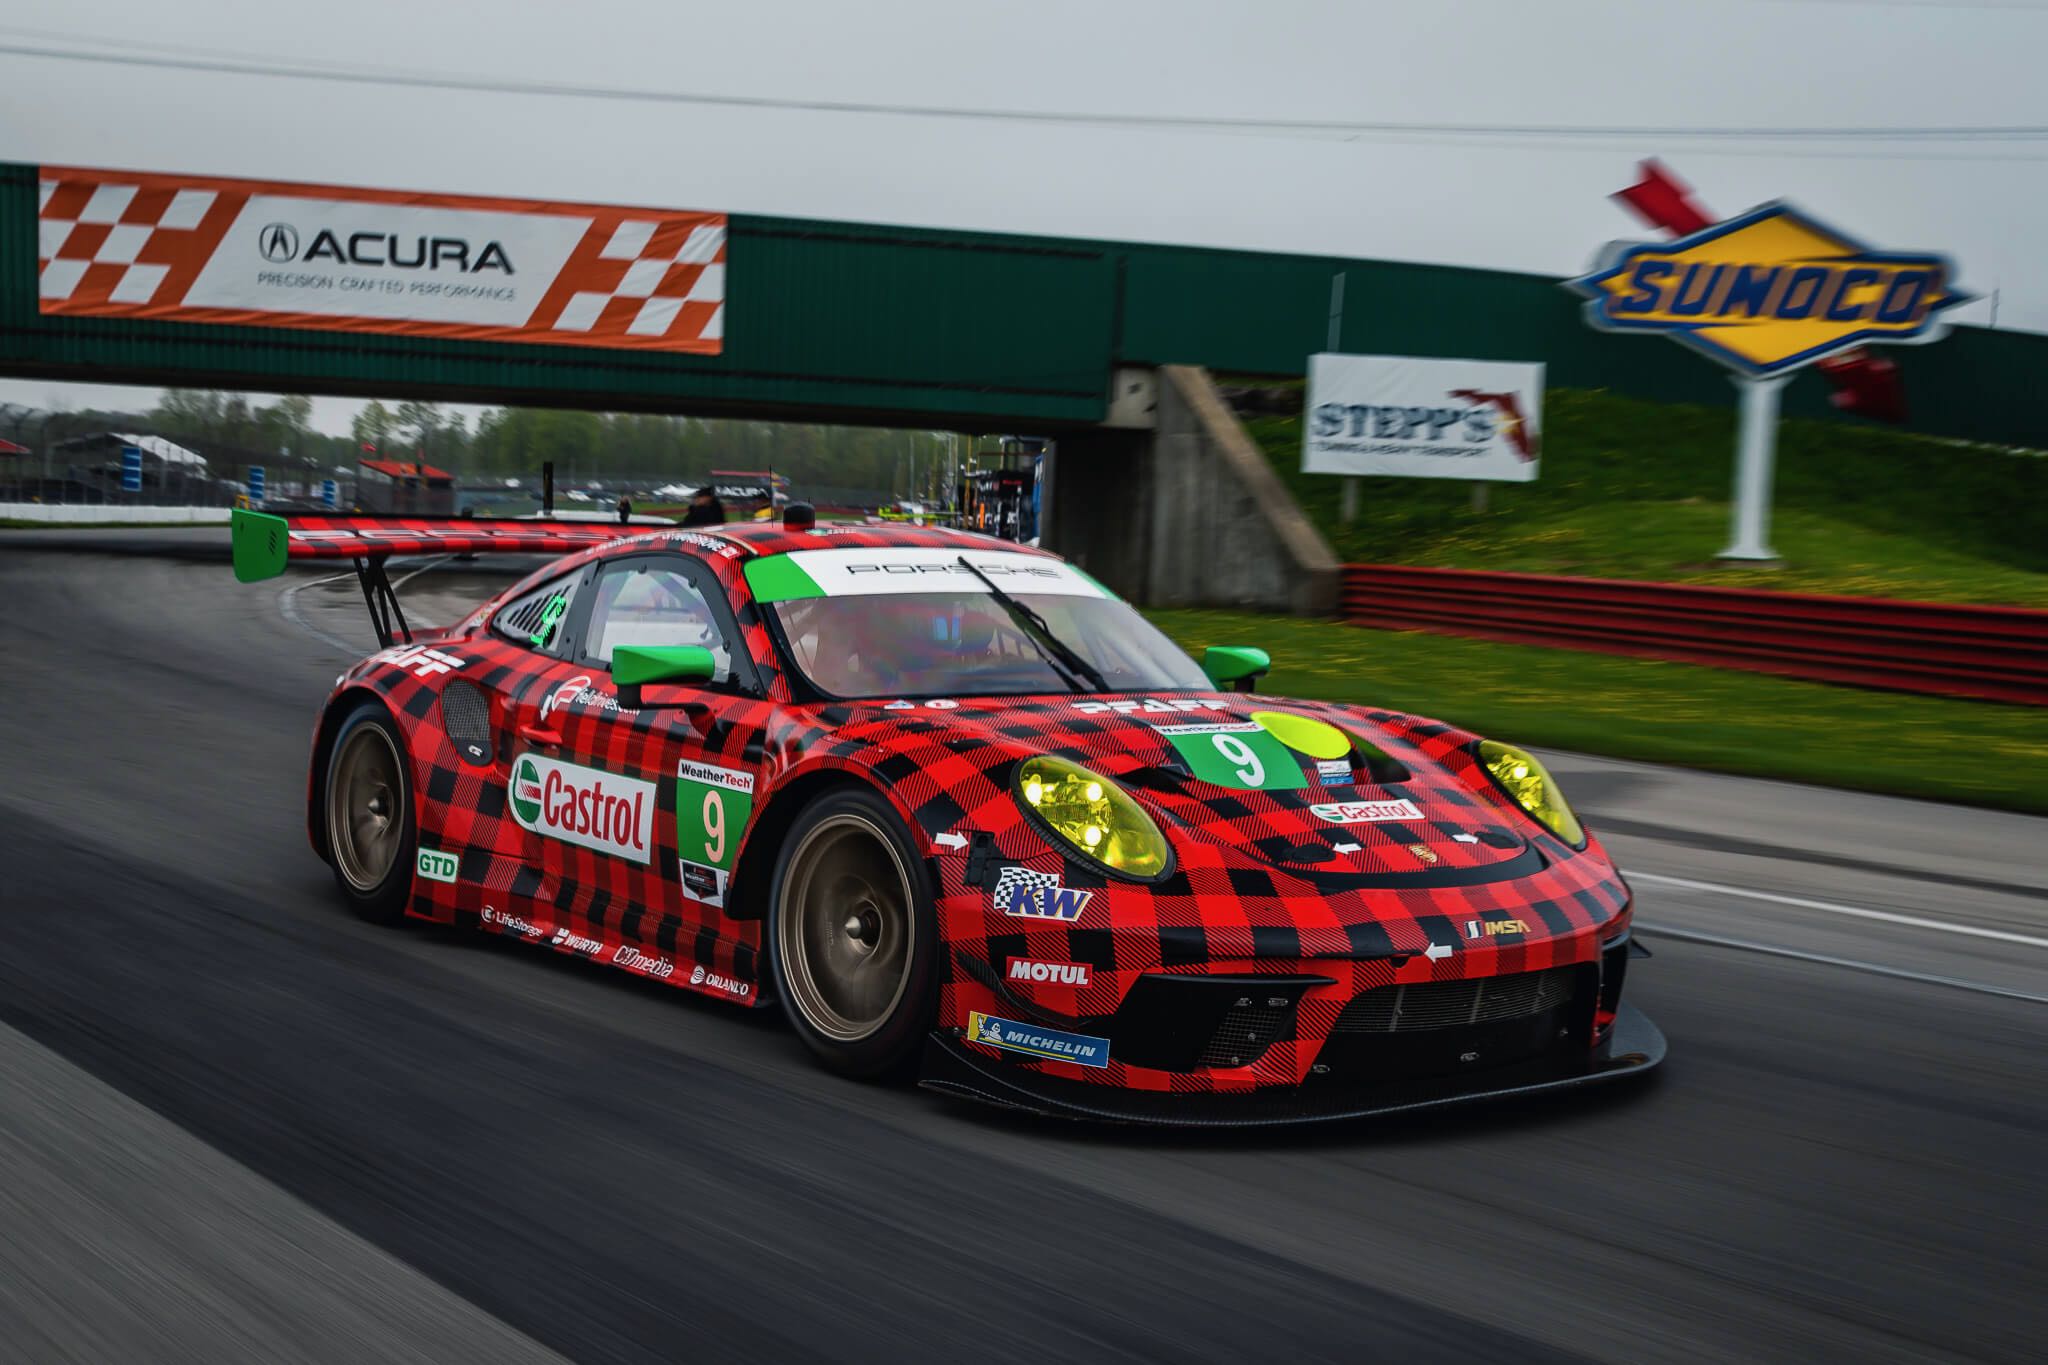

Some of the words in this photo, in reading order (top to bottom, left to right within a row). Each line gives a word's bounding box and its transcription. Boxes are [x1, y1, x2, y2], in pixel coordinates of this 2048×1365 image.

[302, 228, 515, 275] ACURA
[257, 271, 334, 289] PRECISION
[340, 277, 404, 294] CRAFTED
[409, 283, 516, 301] PERFORMANCE
[1616, 260, 1938, 323] SUNOCO
[846, 562, 1062, 579] PORSCHE
[1211, 733, 1266, 787] 9
[681, 763, 752, 789] WeatherTech
[544, 769, 644, 850] Castrol
[1339, 801, 1417, 820] Castrol
[702, 789, 726, 863] 9
[418, 854, 456, 877] GTD
[1009, 883, 1089, 919] KW
[1485, 920, 1532, 936] IMSA
[706, 973, 749, 996] ORLANDO
[1010, 960, 1089, 985] MOTUL
[1005, 1030, 1097, 1057] MICHELIN
